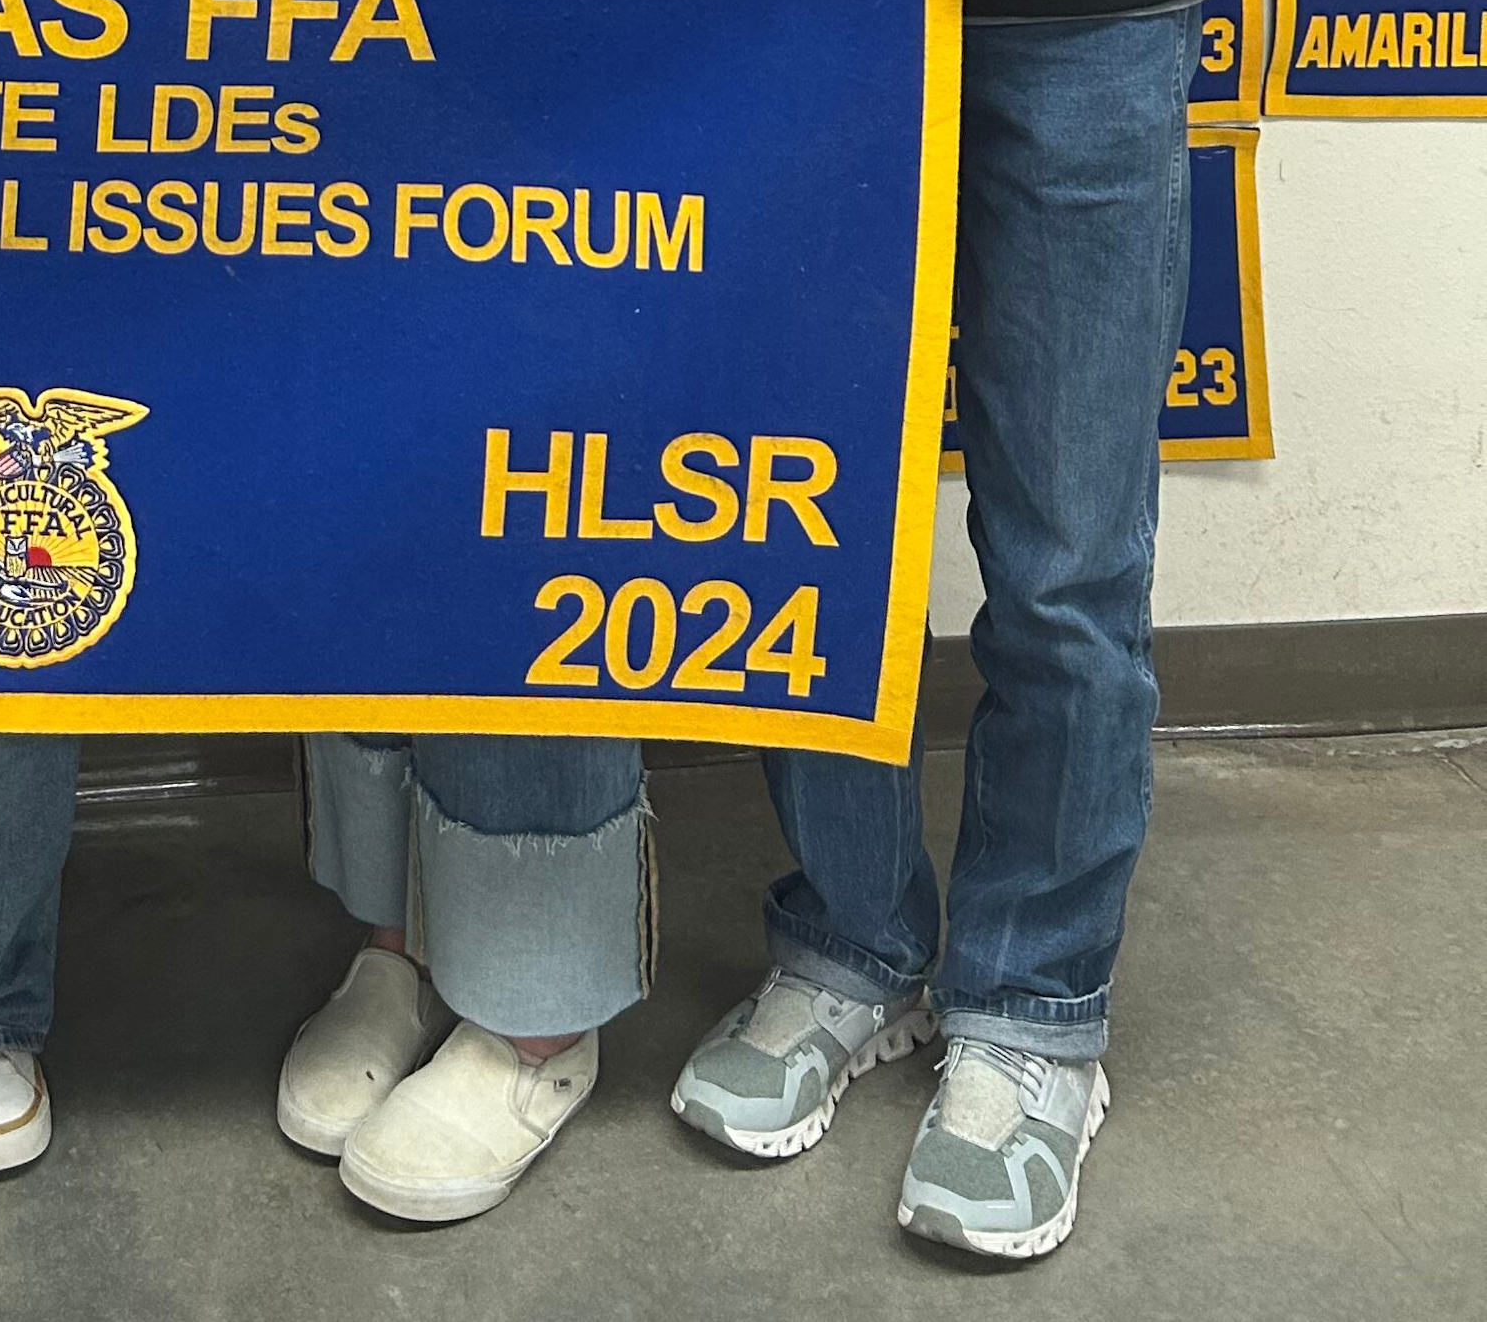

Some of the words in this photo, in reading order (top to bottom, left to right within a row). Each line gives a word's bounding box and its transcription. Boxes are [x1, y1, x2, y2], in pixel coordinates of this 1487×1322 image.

[97, 84, 320, 154] LDEs
[69, 180, 370, 258] ISSUES
[395, 183, 704, 272] FORUM
[1, 510, 67, 536] FFA
[481, 429, 838, 546] HLSR
[526, 575, 826, 697] 2024
